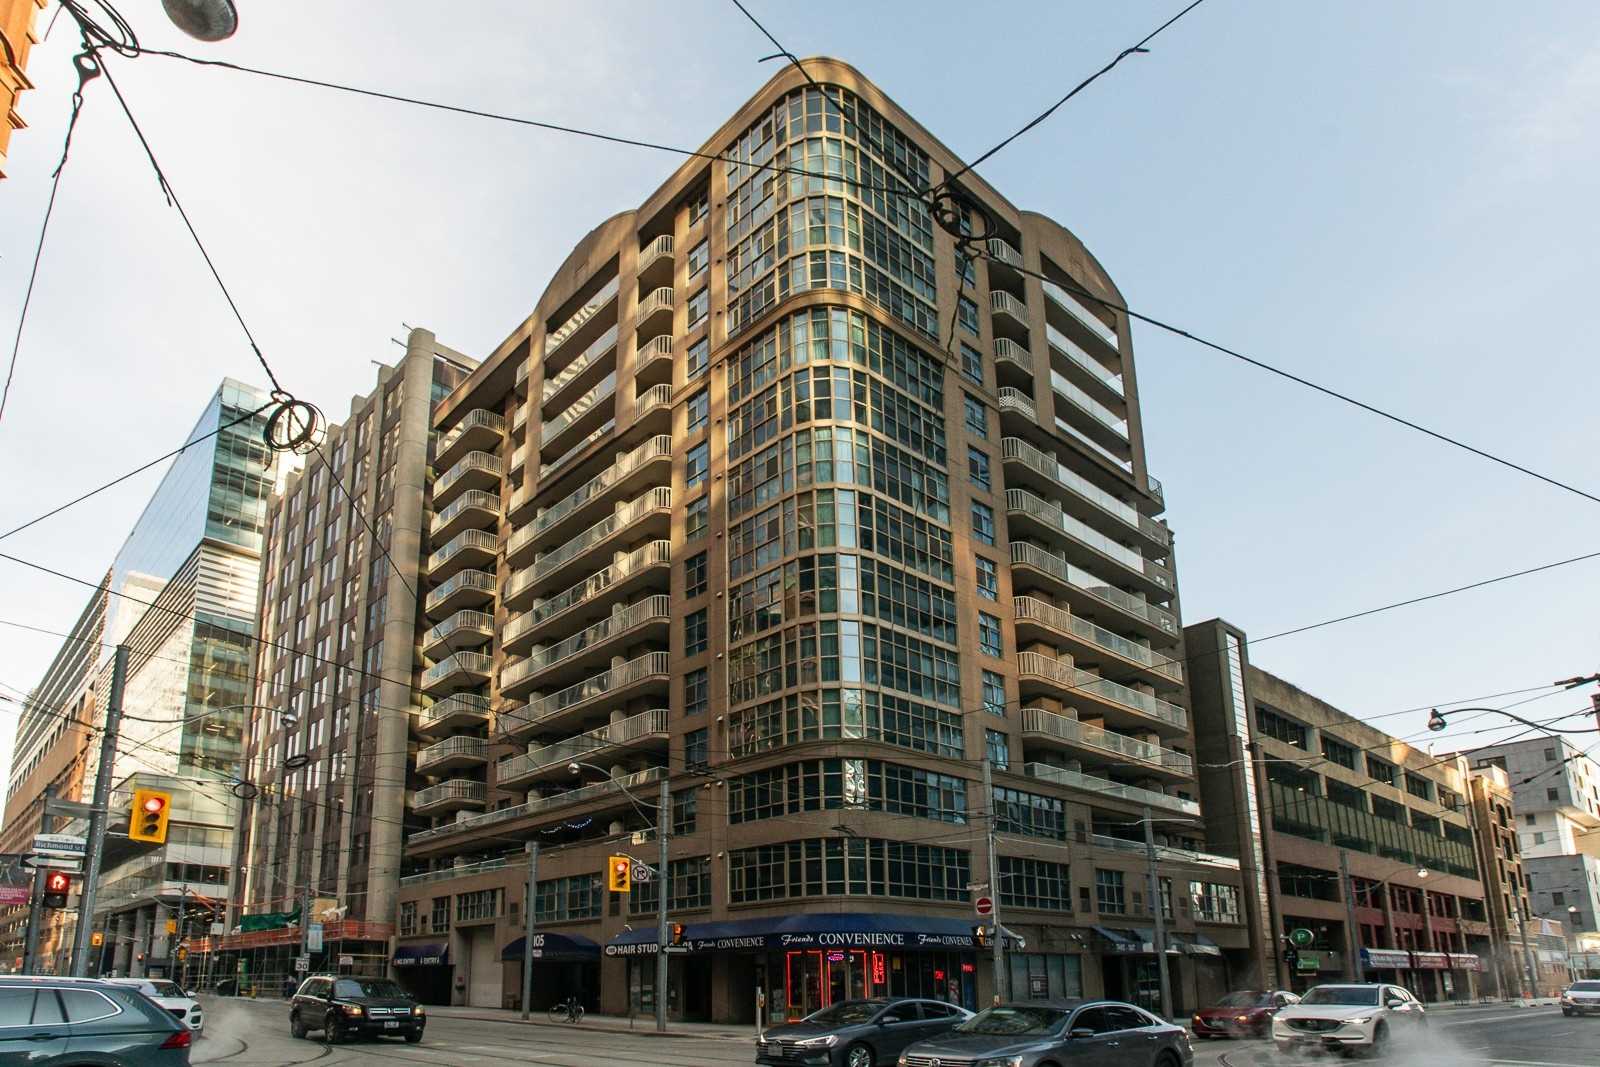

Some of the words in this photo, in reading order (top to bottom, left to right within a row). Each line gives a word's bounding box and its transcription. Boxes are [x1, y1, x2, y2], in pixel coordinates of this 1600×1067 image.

[533, 934, 544, 947] 105
[717, 936, 765, 949] CONVENIENCE
[780, 934, 814, 946] Friends
[818, 932, 905, 946] CONVENIENCE
[917, 934, 942, 945] Friends
[617, 944, 636, 955] HAIR
[637, 943, 659, 954] STUD
